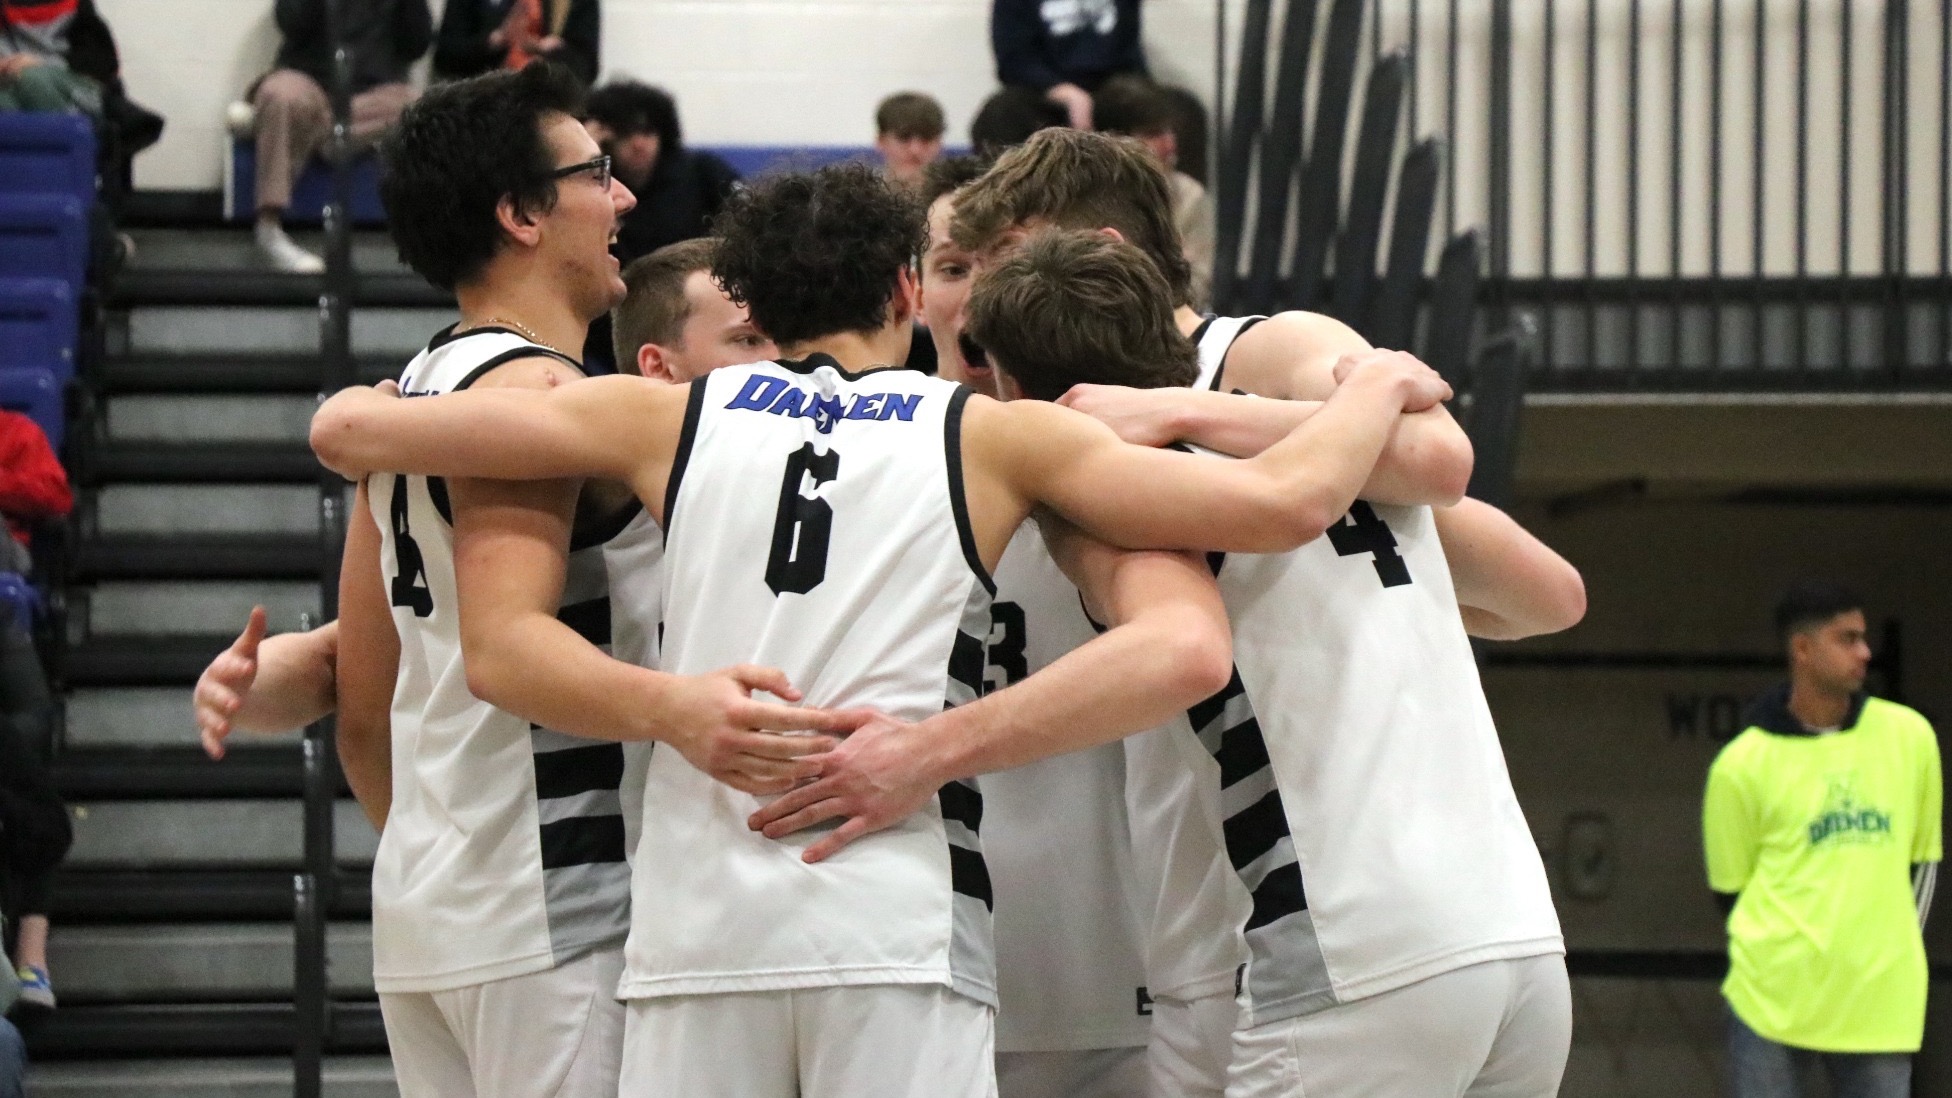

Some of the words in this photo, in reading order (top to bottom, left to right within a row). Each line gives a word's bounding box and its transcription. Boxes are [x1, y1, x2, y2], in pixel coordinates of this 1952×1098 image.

[764, 441, 840, 598] 6
[1325, 498, 1413, 589] 4
[983, 601, 1028, 697] 3
